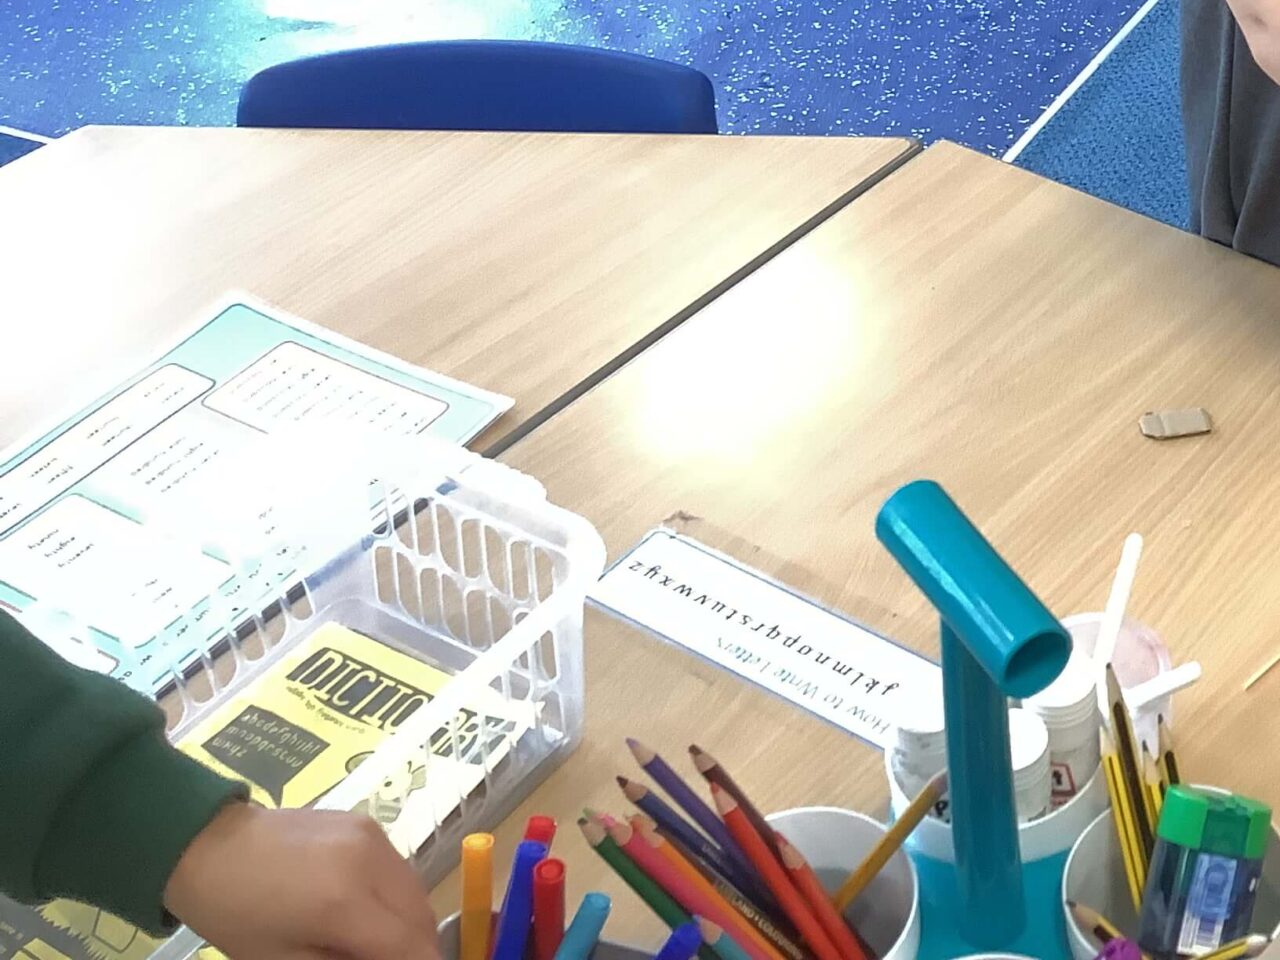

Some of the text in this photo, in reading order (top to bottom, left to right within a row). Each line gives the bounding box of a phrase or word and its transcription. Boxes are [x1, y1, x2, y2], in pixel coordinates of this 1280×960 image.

[716, 637, 891, 735] How to Write Letters
